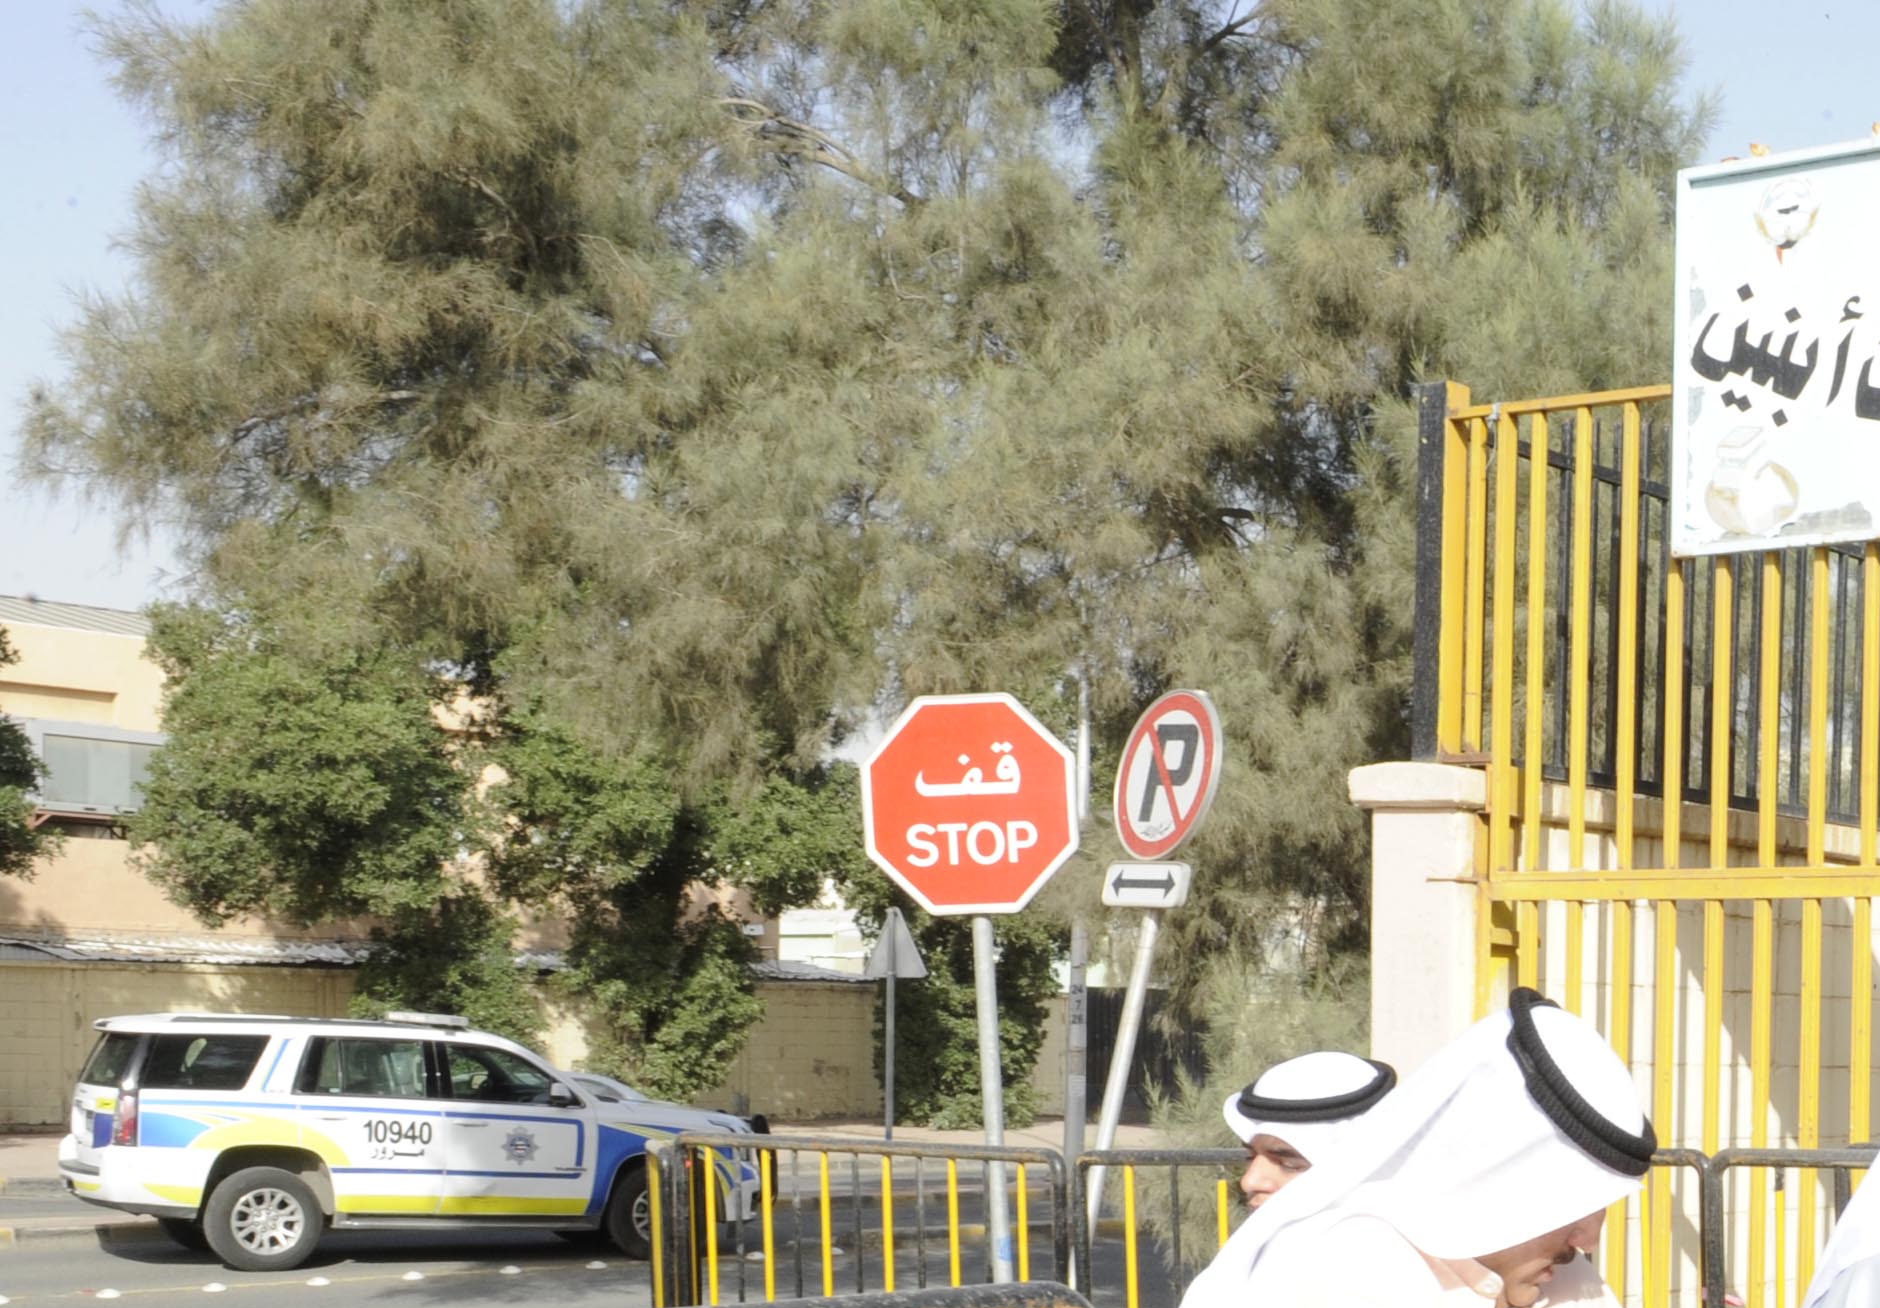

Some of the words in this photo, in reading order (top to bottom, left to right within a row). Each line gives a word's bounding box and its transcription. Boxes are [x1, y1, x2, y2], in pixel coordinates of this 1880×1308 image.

[914, 741, 1021, 797] قف
[905, 820, 1039, 868] STOP
[363, 1119, 433, 1145] 10940
[370, 1147, 425, 1161] مرور
